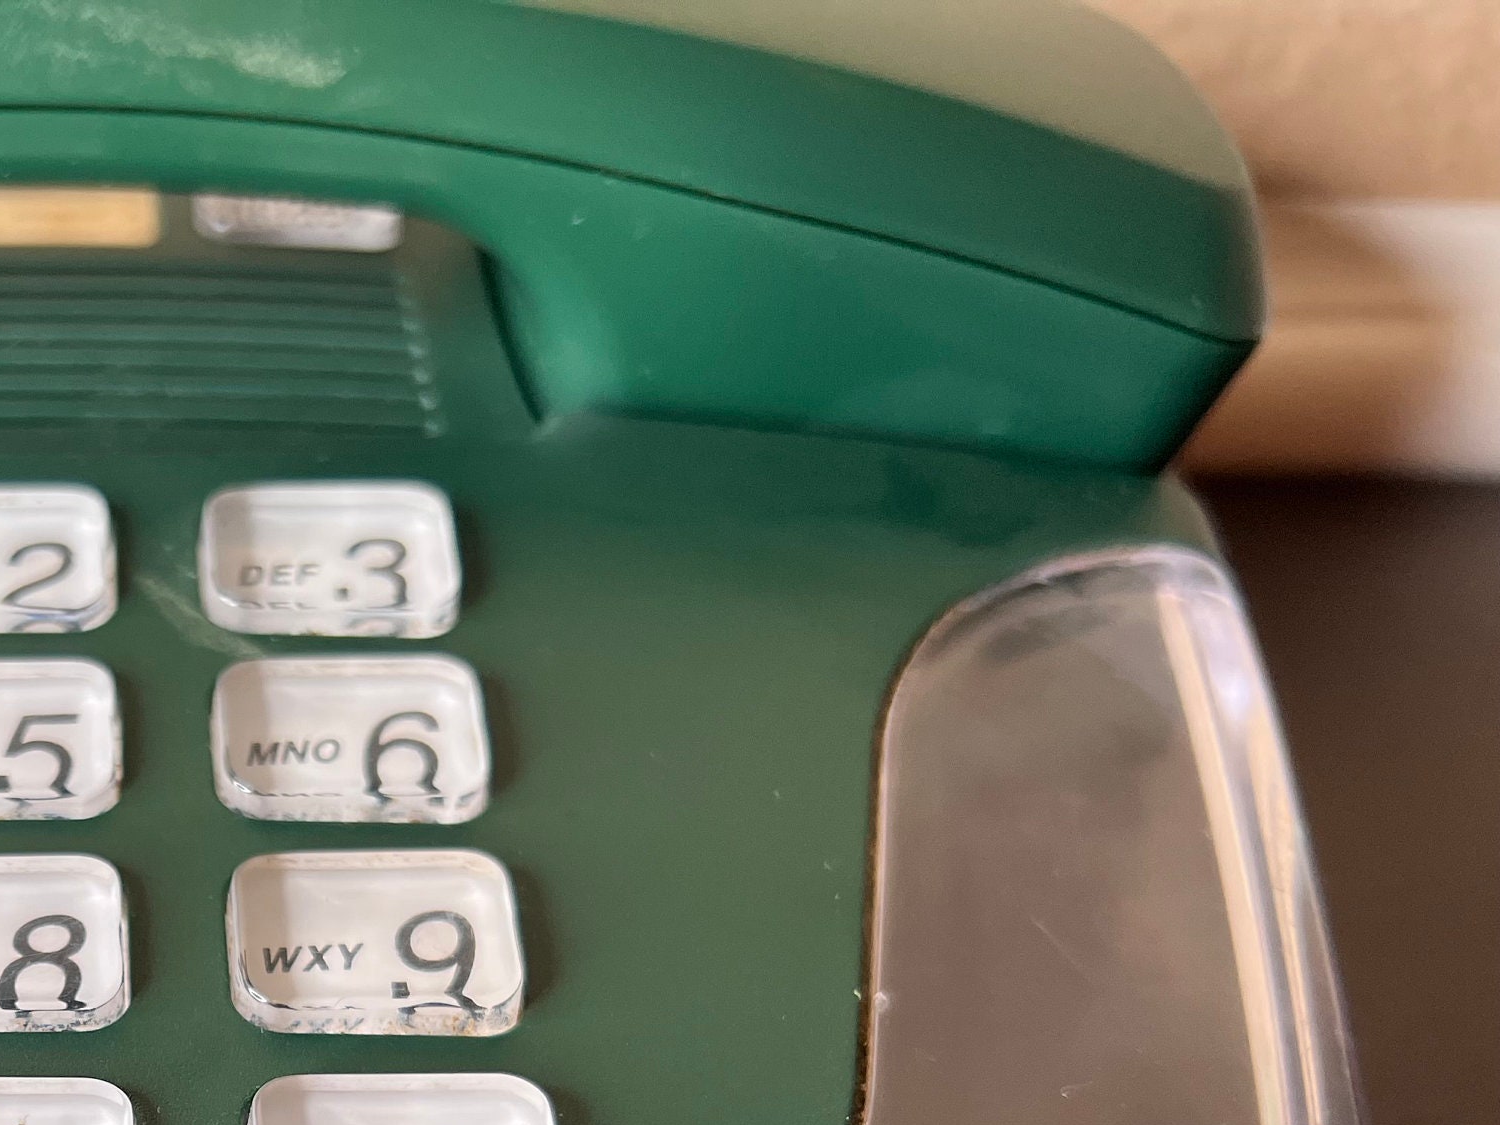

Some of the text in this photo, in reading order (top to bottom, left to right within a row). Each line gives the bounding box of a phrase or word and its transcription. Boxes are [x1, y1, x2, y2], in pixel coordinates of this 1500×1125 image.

[2, 543, 74, 609] 2
[238, 539, 407, 608] DEF 3
[247, 712, 441, 804] MNO 6
[263, 910, 486, 1020] WXY 9
